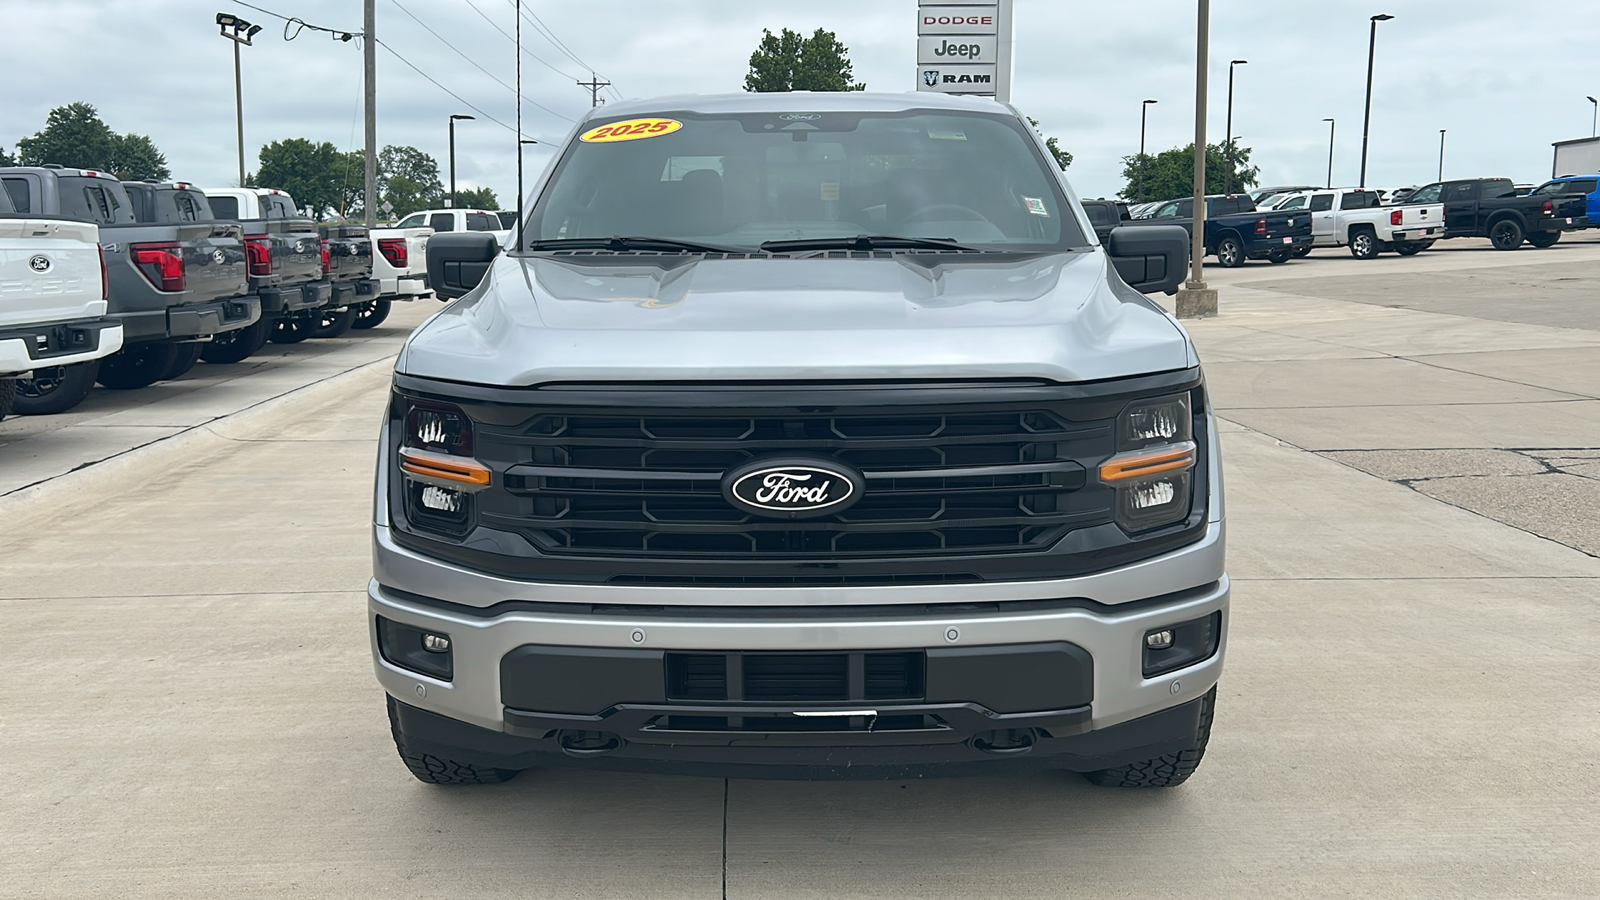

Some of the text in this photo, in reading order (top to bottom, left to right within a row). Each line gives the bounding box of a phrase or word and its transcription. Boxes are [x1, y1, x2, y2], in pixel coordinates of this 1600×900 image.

[924, 16, 992, 25] DODGE
[934, 40, 981, 60] Jeep
[942, 74, 991, 83] RAM
[589, 121, 673, 140] 2025
[755, 472, 830, 503] Ford
